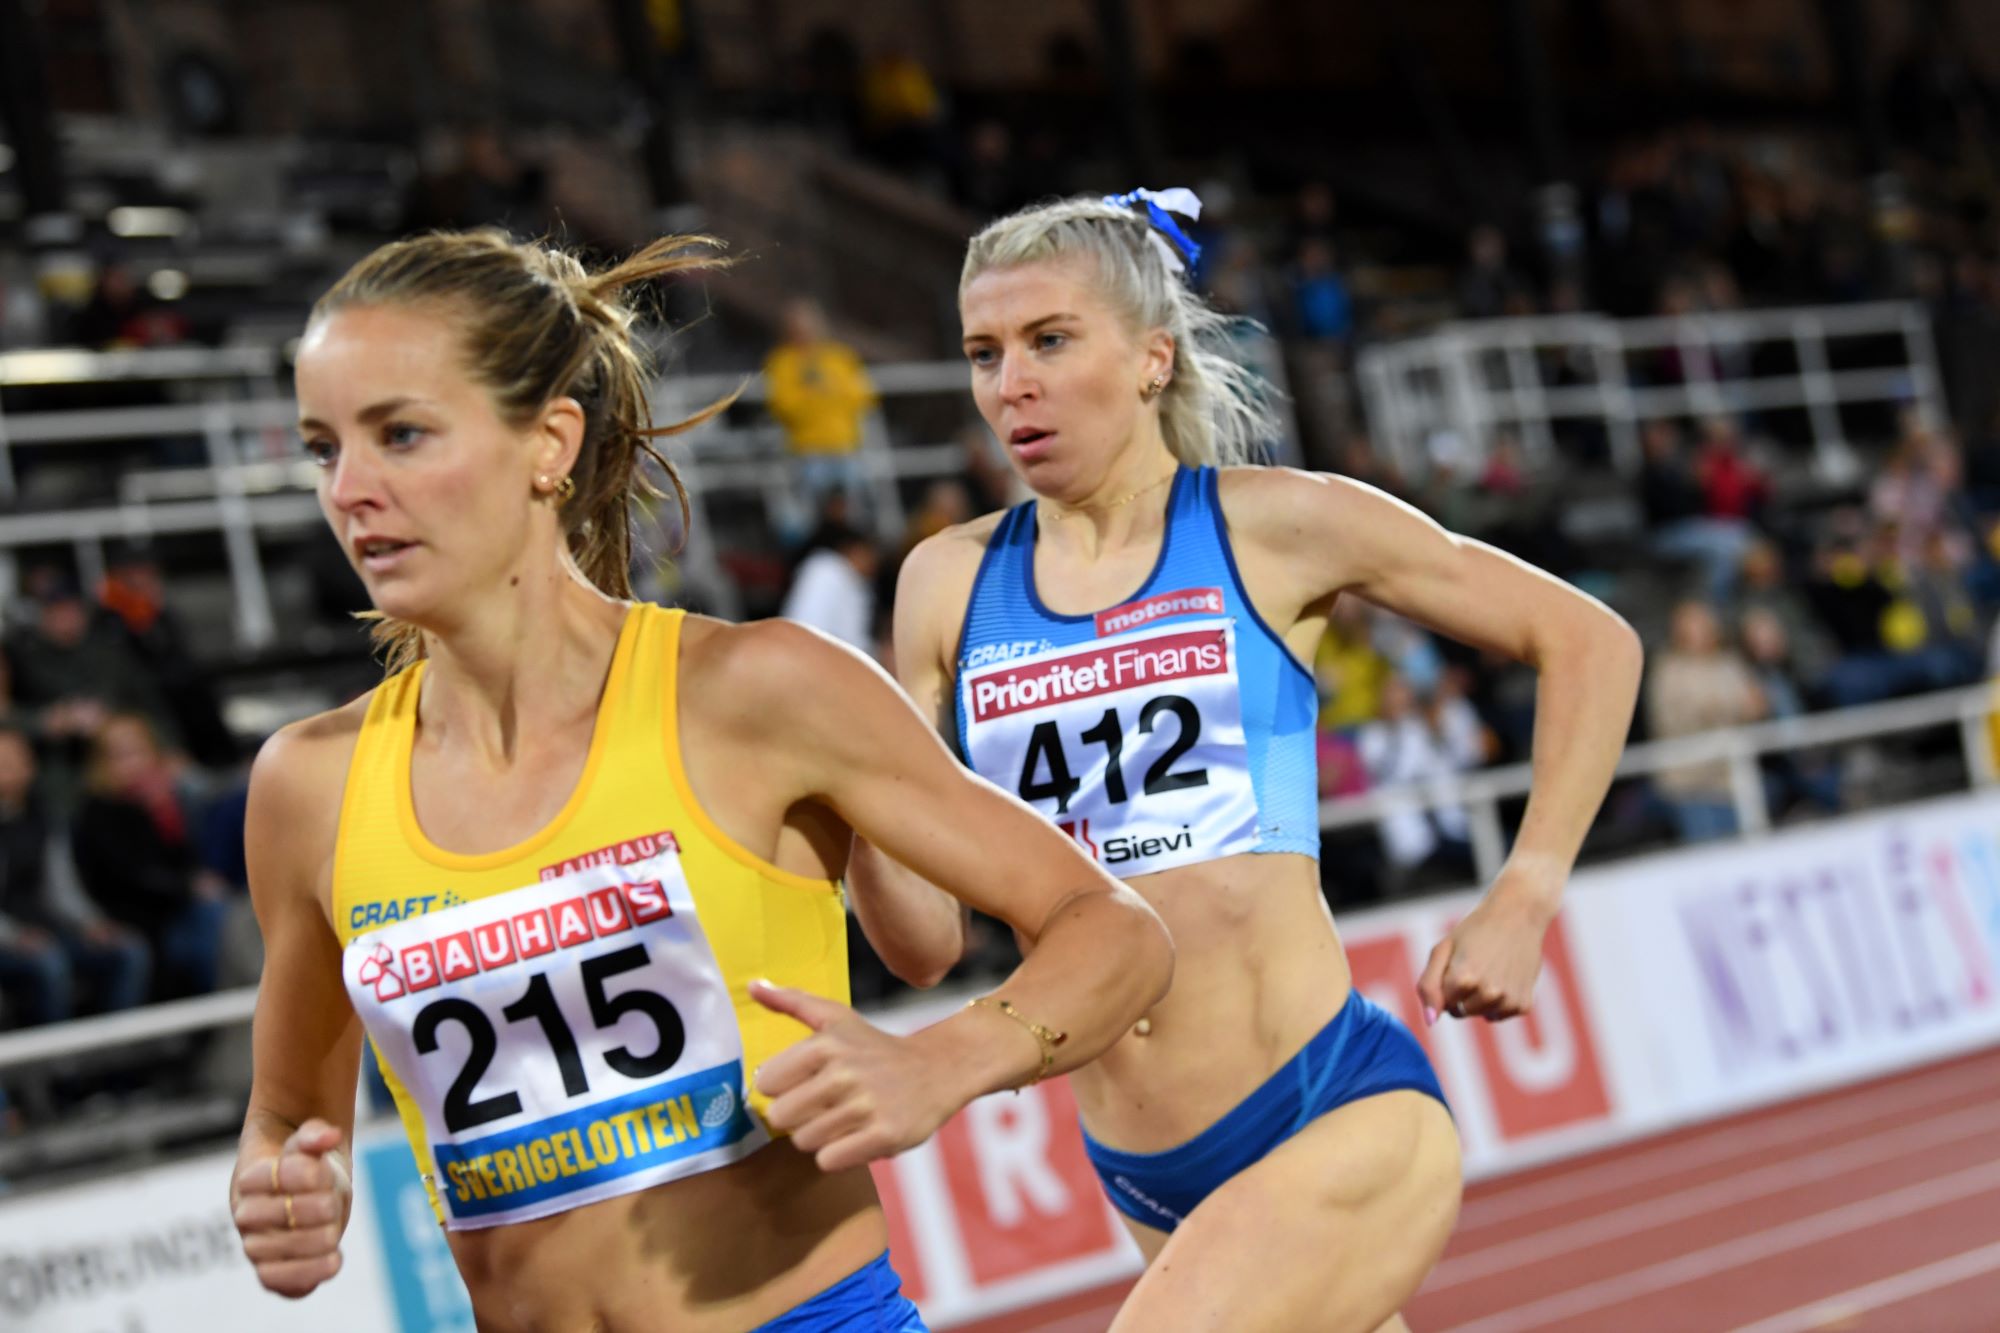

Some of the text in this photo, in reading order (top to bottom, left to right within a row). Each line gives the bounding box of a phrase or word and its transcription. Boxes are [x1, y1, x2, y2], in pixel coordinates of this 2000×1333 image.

[1103, 591, 1220, 633] motonet
[967, 640, 1038, 668] CRAFT
[974, 643, 1222, 716] Prioritet Finans
[1017, 694, 1209, 814] 412
[1102, 824, 1193, 865] Sievi
[350, 894, 436, 929] CRAFT
[404, 883, 669, 984] BAUHAUS
[411, 942, 686, 1135] 215
[446, 1093, 702, 1202] SVERIGELOTTEN
